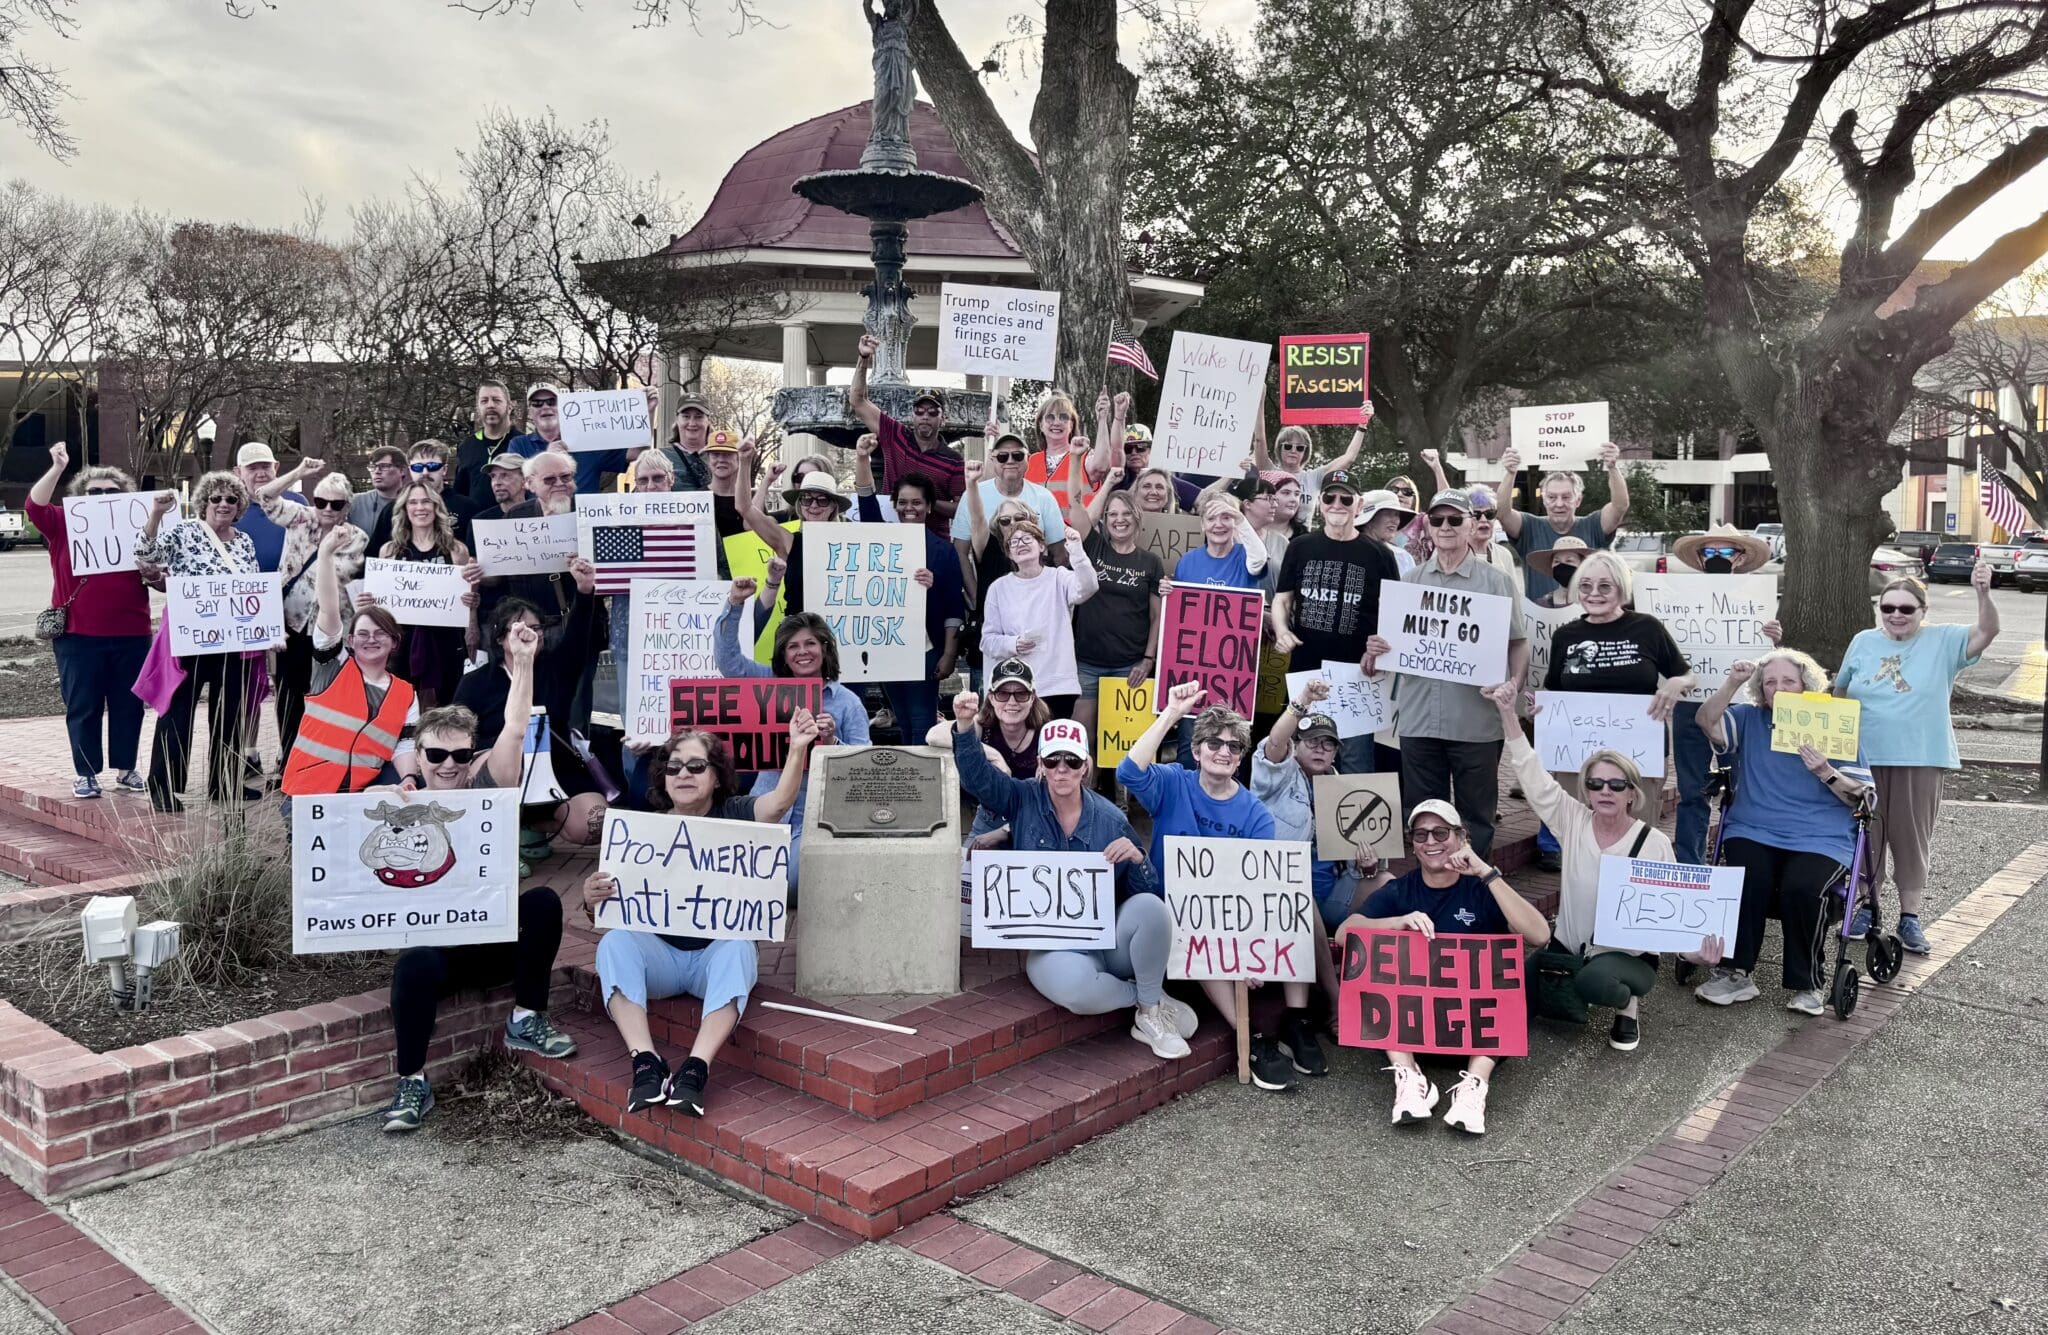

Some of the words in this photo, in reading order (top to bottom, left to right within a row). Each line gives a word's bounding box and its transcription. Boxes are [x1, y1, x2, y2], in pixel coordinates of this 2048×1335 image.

[944, 293, 990, 311] Trump
[1007, 298, 1055, 317] closing
[953, 312, 1013, 327] agencies
[1017, 318, 1043, 331] and
[955, 327, 997, 345] firings
[1003, 334, 1026, 345] are
[964, 344, 1019, 361] ILLEGAL
[1183, 337, 1227, 369] Wake
[1238, 348, 1260, 385] Up
[1287, 344, 1363, 366] RESIST
[1178, 369, 1237, 409] Trump
[583, 398, 640, 414] TRUMP
[1170, 402, 1184, 422] is
[1193, 405, 1238, 432] Putin's
[1545, 412, 1575, 421] STOP
[610, 415, 649, 431] MUSK
[1538, 425, 1586, 435] DONALD
[1166, 435, 1228, 468] Puppet
[1538, 440, 1566, 448] Elon,
[578, 505, 612, 518] Honk
[619, 503, 638, 515] for
[645, 502, 710, 514] FREEDOM
[73, 536, 122, 570] MU
[826, 542, 904, 573] FIRE
[182, 582, 200, 597] WE
[207, 581, 227, 595] THE
[232, 579, 269, 594] PEOPLE
[825, 574, 908, 607] ELON
[1300, 588, 1339, 601] WAKE
[1343, 591, 1362, 605] UP
[195, 599, 220, 614] SAY
[230, 595, 260, 616] NO
[1179, 591, 1259, 632] FIRE
[1420, 590, 1472, 617] MUSK
[645, 613, 671, 630] THE
[677, 613, 713, 630] ONLY
[825, 615, 906, 646] MUSK
[1402, 614, 1449, 639] MUST
[1458, 622, 1480, 643] GO
[193, 627, 225, 645] ELON
[643, 633, 713, 650] MINORITY
[1414, 638, 1458, 658] SAVE
[642, 653, 720, 671] DESTROYI
[1176, 628, 1259, 673] ELON
[1400, 652, 1477, 677] DEMOCRACY
[640, 674, 663, 691] THE
[1166, 669, 1252, 714] MUSK
[639, 696, 666, 712] ARE
[672, 685, 742, 726] SEE
[752, 684, 821, 725] YOU
[1115, 688, 1147, 712] NO
[637, 716, 670, 734] BILLI
[1547, 699, 1635, 737] Measles
[1044, 725, 1082, 743] USA
[1103, 730, 1138, 751] Mu
[311, 804, 326, 882] BAD
[479, 799, 493, 878] DOGE
[1177, 846, 1214, 878] NO
[1242, 849, 1303, 884] ONE
[1632, 866, 1643, 877] THE
[1644, 868, 1671, 881] CRUELTY
[1671, 871, 1679, 881] IS
[1679, 872, 1692, 882] THE
[1692, 873, 1711, 884] POINT
[984, 864, 1109, 920] RESIST
[307, 916, 356, 932] Paws
[361, 912, 397, 928] OFF
[406, 911, 441, 926] Our
[446, 908, 488, 924] Data
[1168, 893, 1253, 932] VOTED
[1263, 892, 1311, 934] FOR
[1615, 884, 1737, 937] RESIST
[1185, 934, 1297, 978] MUSK
[1342, 932, 1521, 990] DELETE
[1359, 991, 1500, 1049] DOGE
